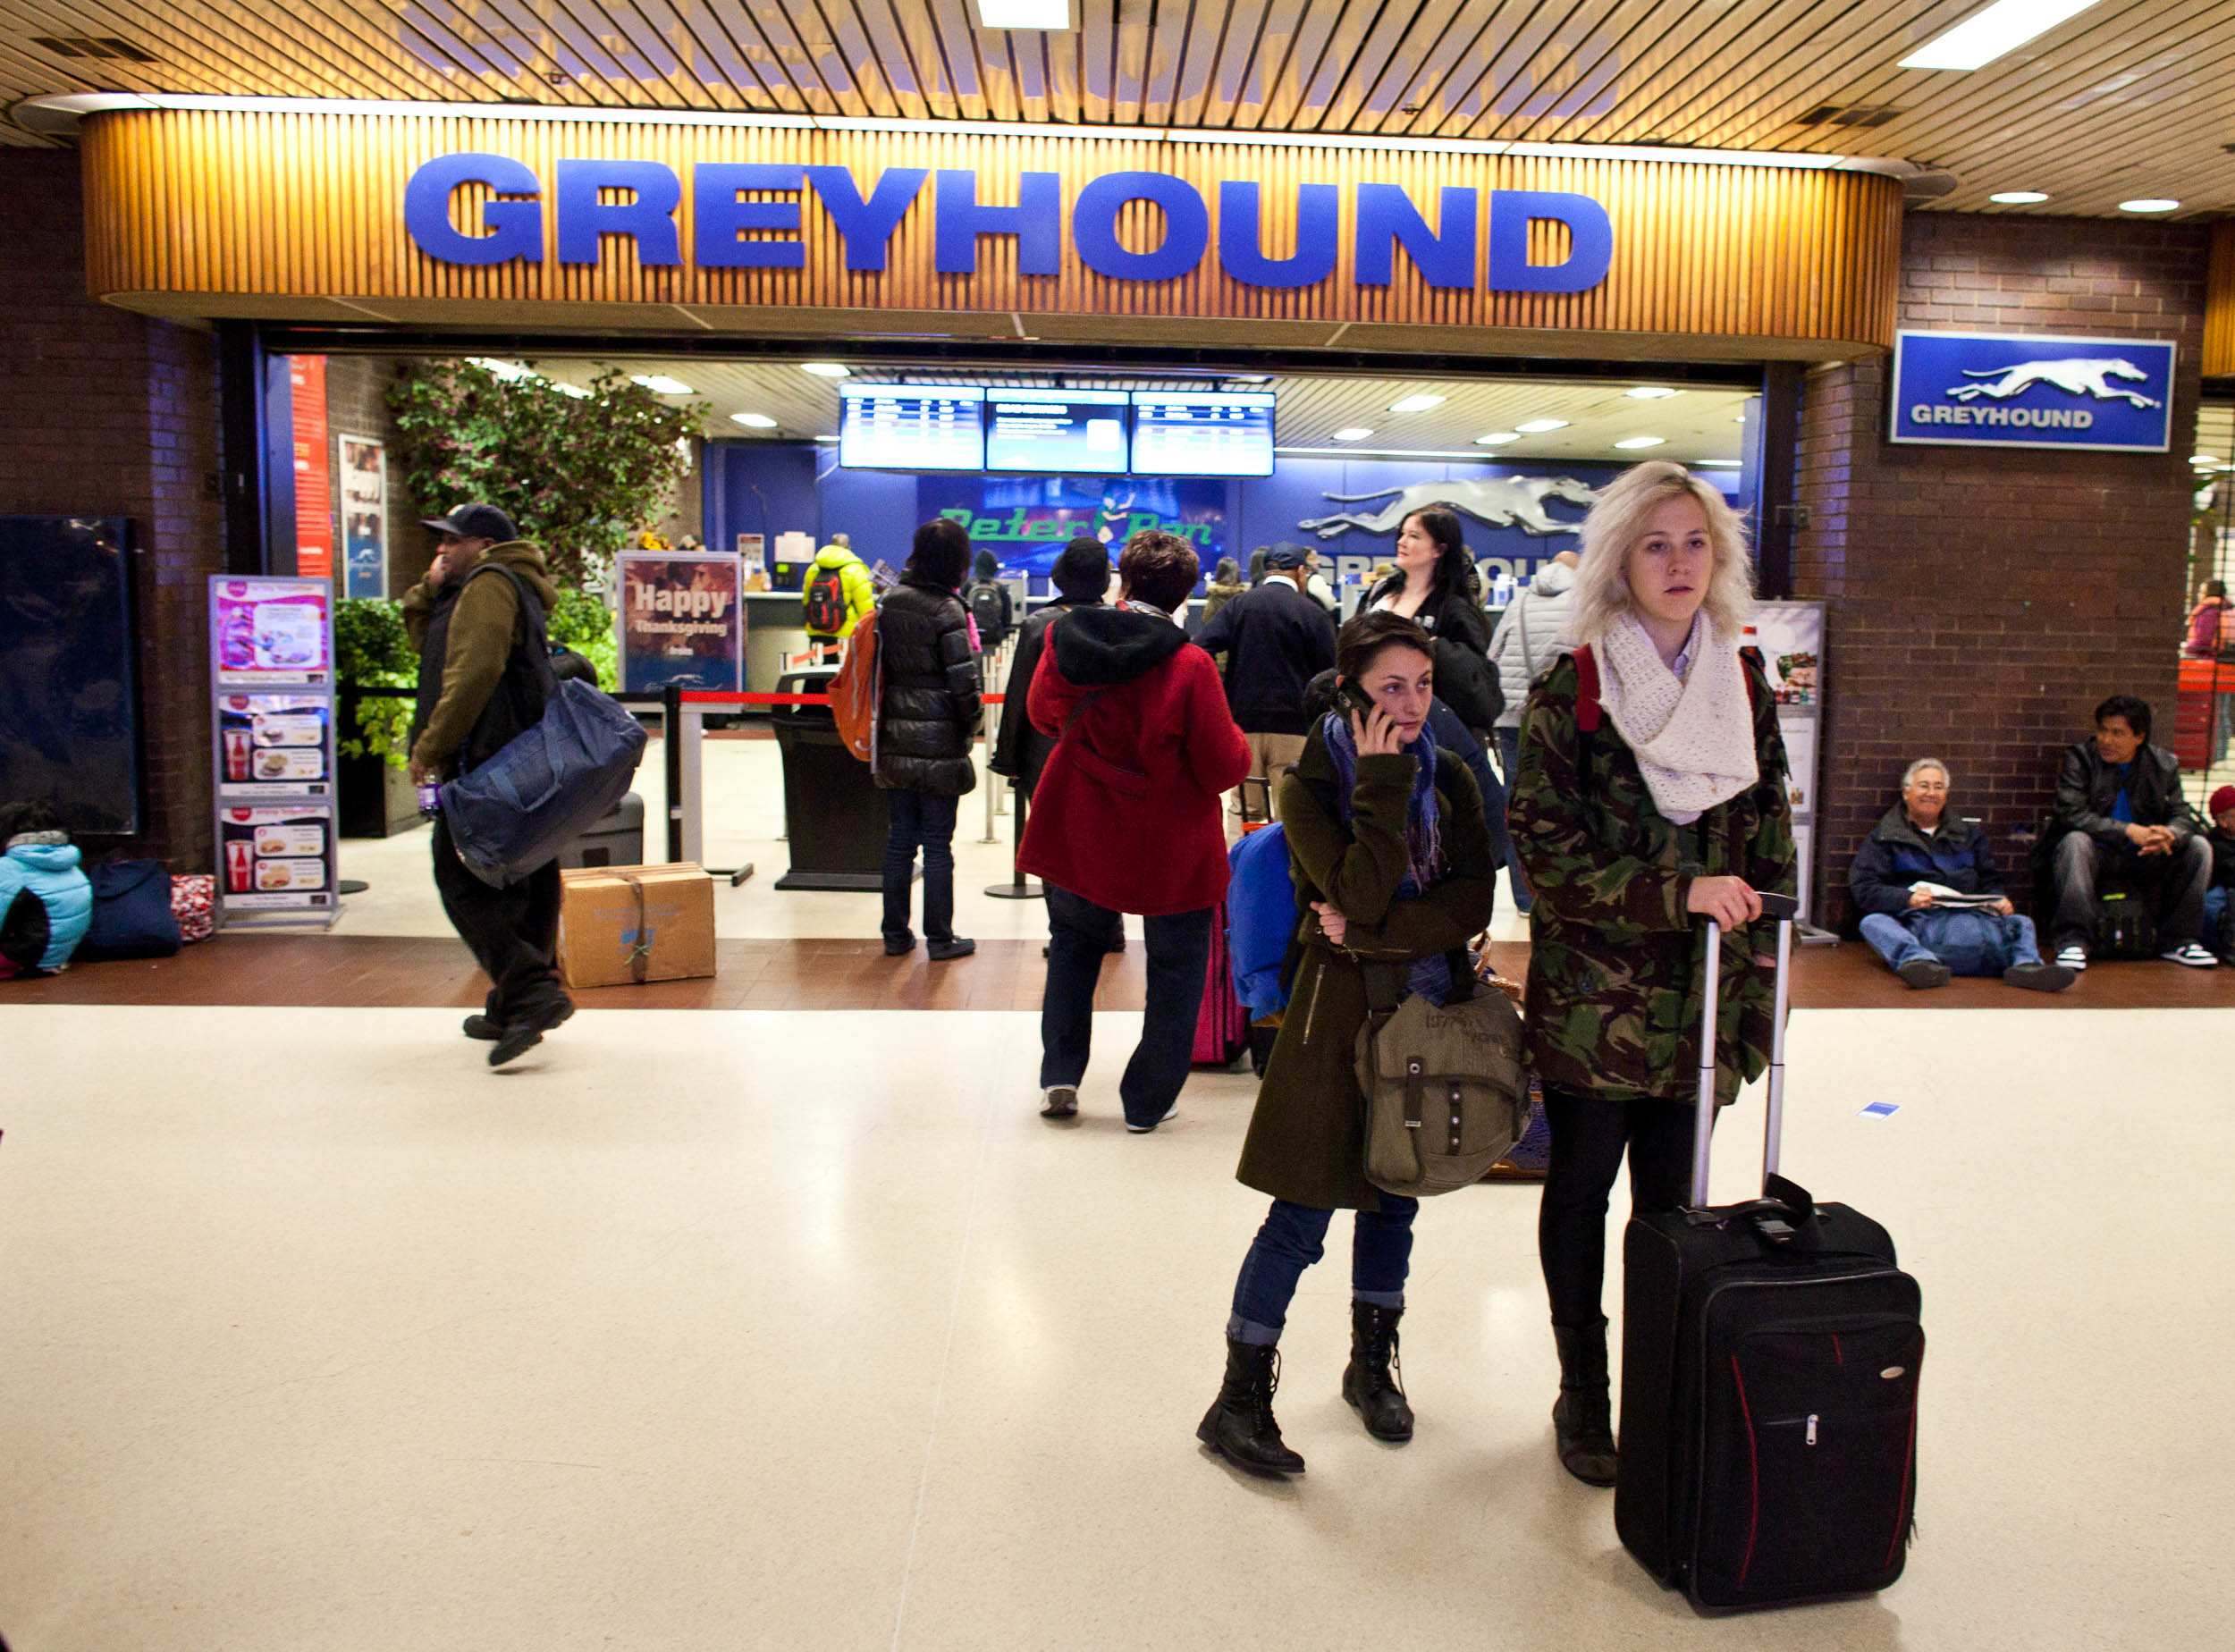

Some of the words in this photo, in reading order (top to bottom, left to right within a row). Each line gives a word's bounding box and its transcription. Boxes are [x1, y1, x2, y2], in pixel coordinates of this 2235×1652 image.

[405, 153, 1615, 293] GREYHOUND
[1911, 405, 2093, 429] GREYHOUND
[939, 508, 1089, 542] Peter
[1120, 512, 1212, 545] Pan
[635, 584, 729, 619] Happy
[637, 620, 728, 637] Thanksgiving
